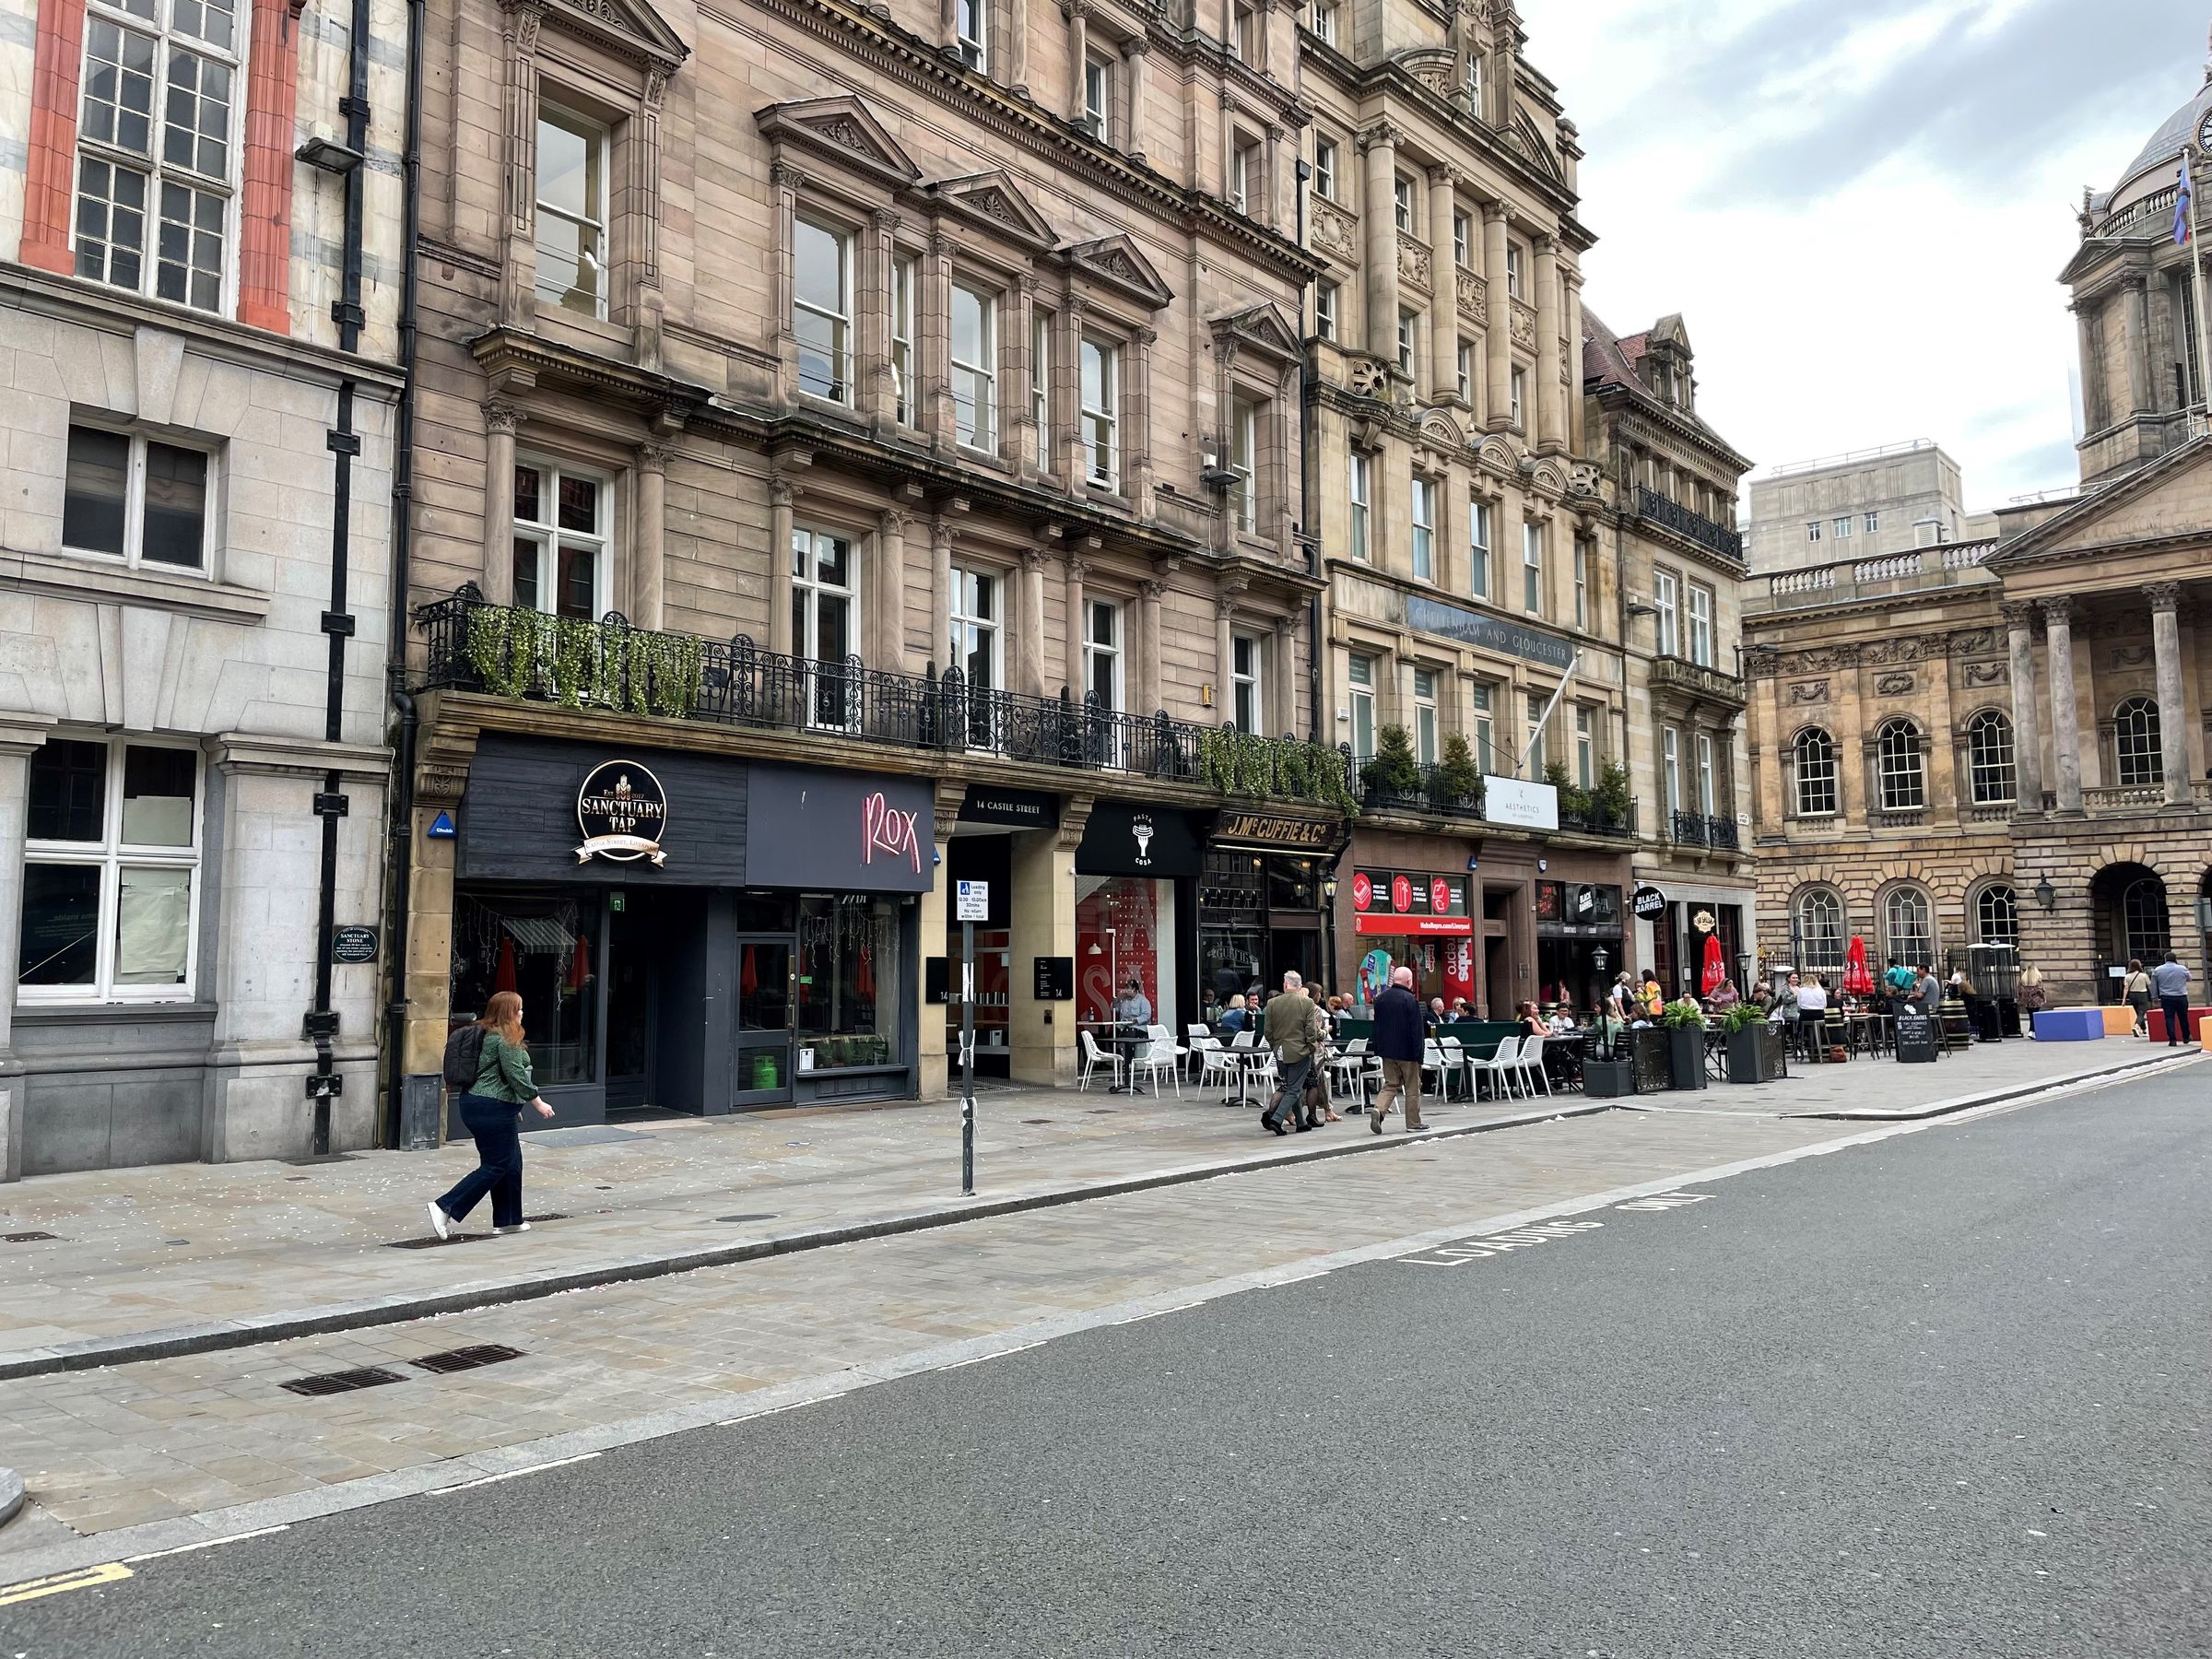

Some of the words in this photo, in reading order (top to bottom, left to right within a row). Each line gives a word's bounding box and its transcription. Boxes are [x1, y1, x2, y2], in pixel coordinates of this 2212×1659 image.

[1486, 629, 1506, 644] AND
[1512, 635, 1567, 661] GLOUCESTER
[582, 797, 664, 818] SANCTUARY
[977, 800, 984, 809] 14
[987, 801, 1014, 812] CASTLE
[1016, 804, 1041, 814] STREET
[1505, 803, 1539, 814] AESTHETICS
[609, 816, 636, 832] TAP
[1133, 813, 1152, 824] PASTA
[1135, 857, 1152, 866] COSA
[1580, 891, 1592, 903] BLACK
[1636, 892, 1660, 904] BLACK
[1579, 899, 1594, 912] BARREL
[1635, 900, 1663, 913] BARREL
[1445, 937, 1457, 975] repro
[1457, 937, 1472, 982] hobs
[940, 992, 947, 1000] 14
[1055, 988, 1062, 997] 14
[1615, 1192, 1717, 1211] ONLY
[1396, 1220, 1606, 1266] LOADING
